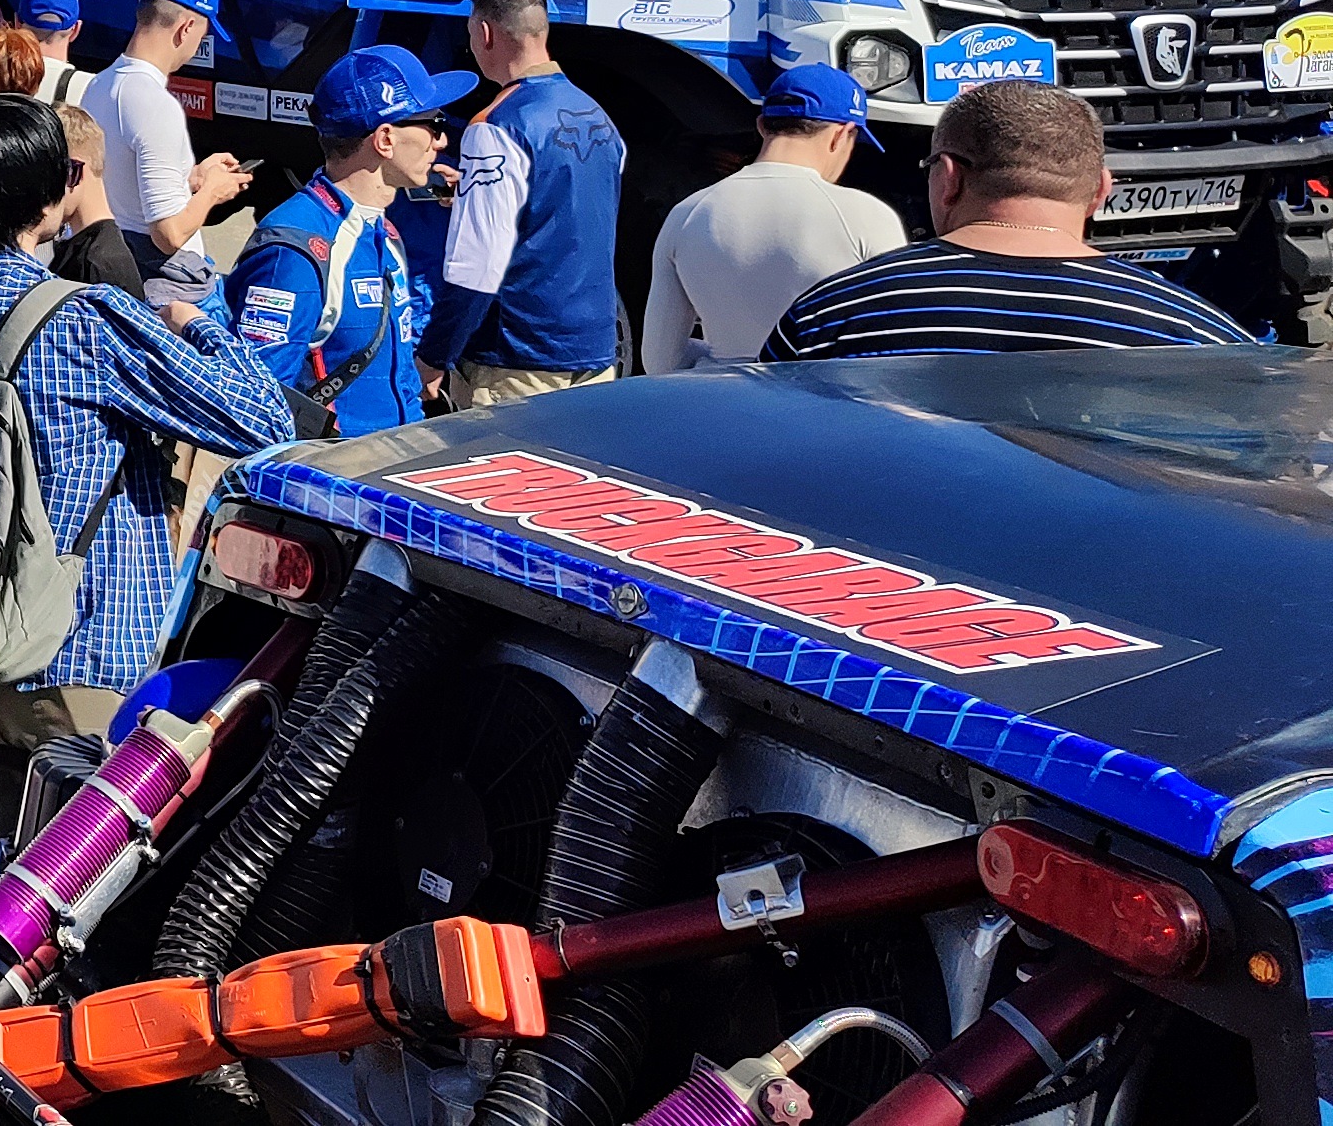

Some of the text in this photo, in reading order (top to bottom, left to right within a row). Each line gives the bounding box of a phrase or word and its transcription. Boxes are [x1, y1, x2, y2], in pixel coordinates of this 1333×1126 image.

[960, 30, 1017, 58] Team
[934, 59, 1044, 80] KAMAZ
[1204, 179, 1236, 201] 716
[1145, 249, 1188, 259] TYRES
[389, 450, 1164, 674] TRUCKGARAGE
